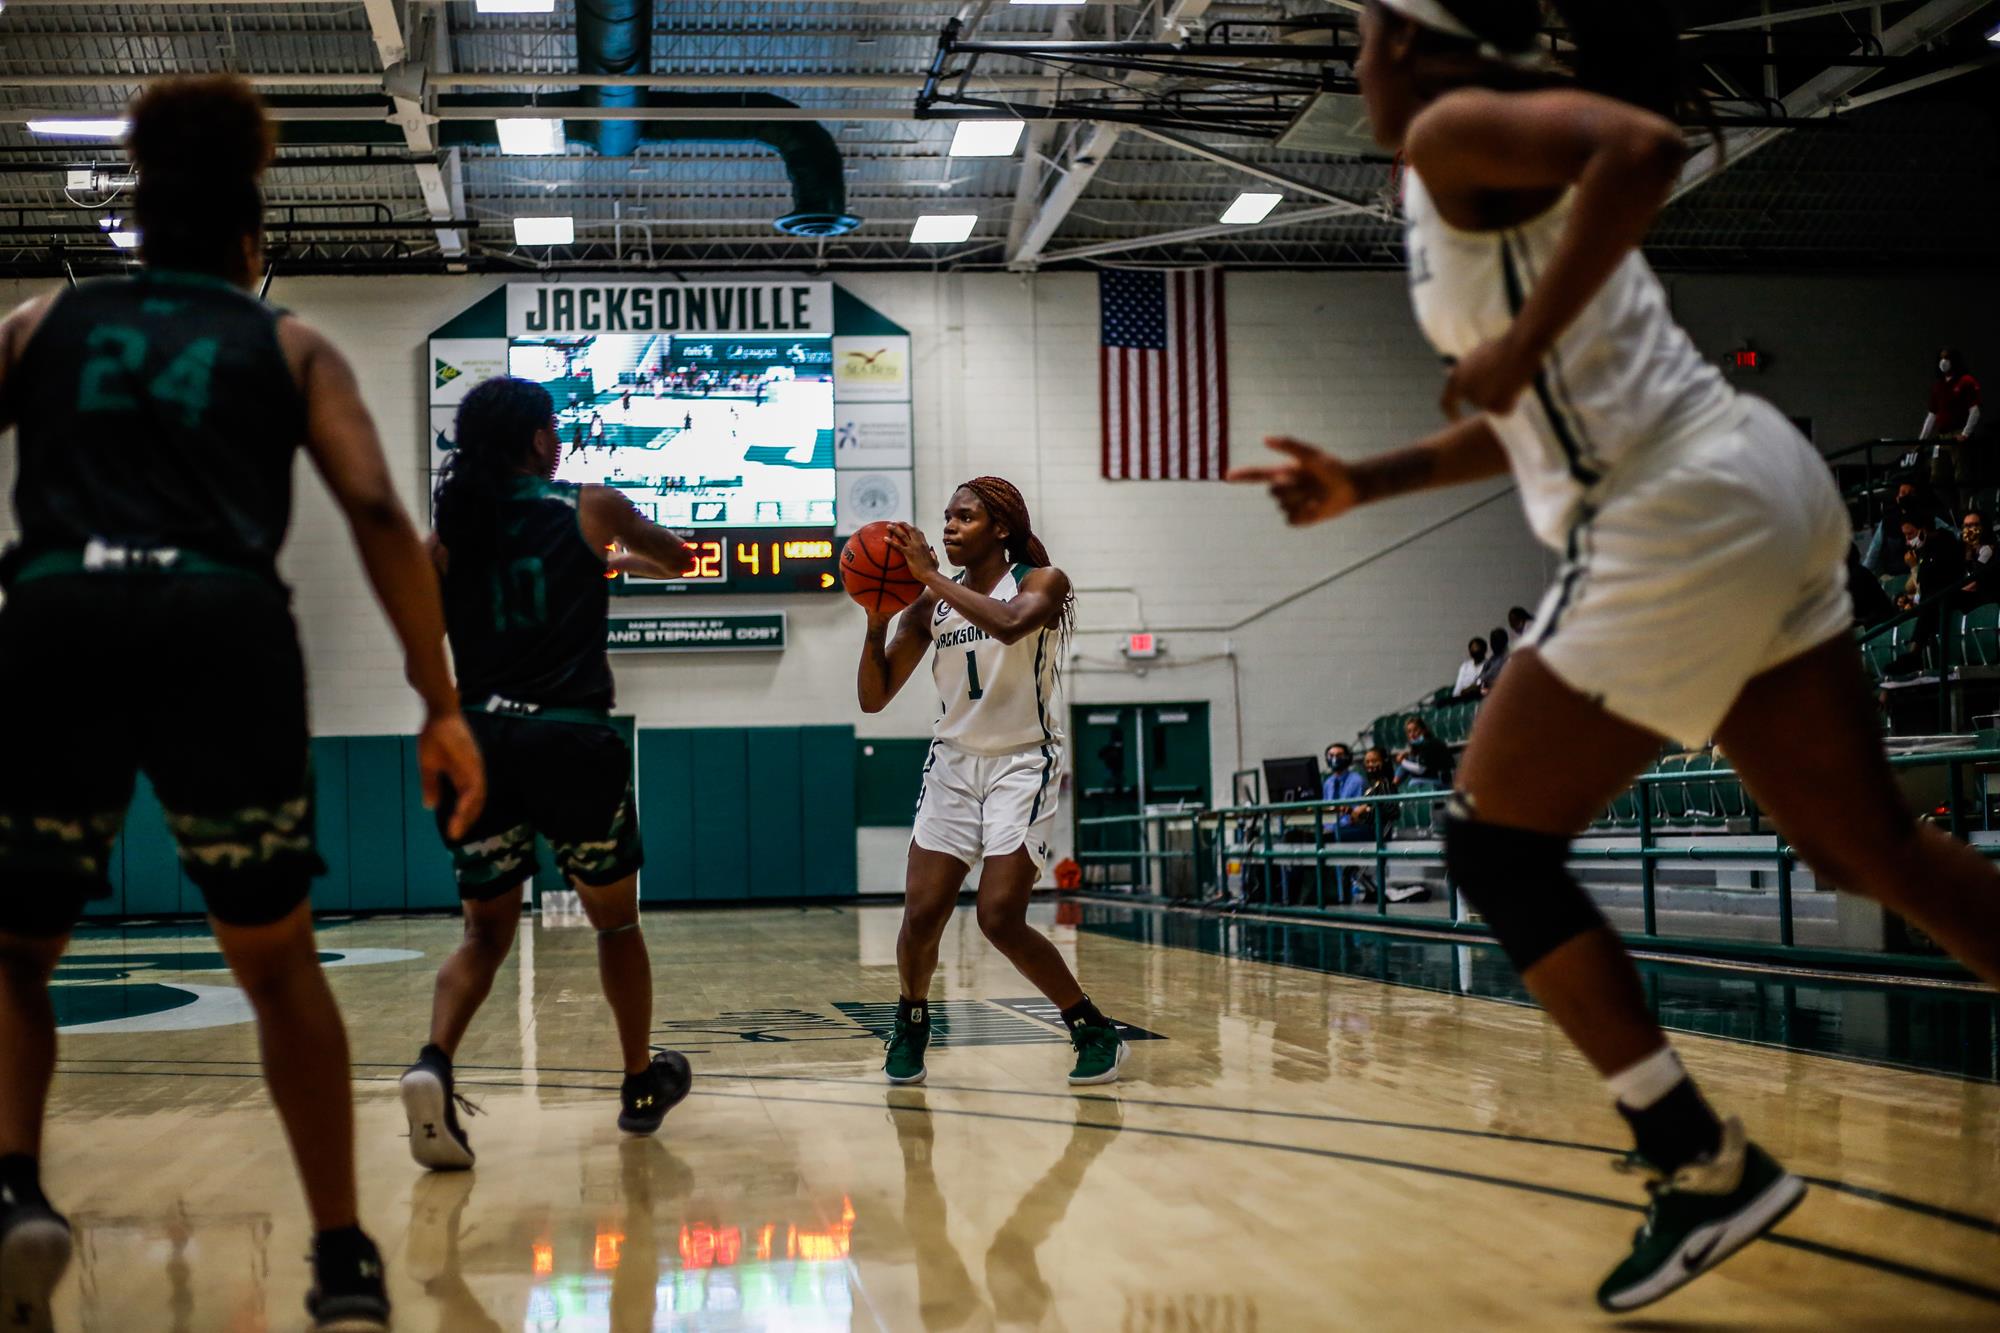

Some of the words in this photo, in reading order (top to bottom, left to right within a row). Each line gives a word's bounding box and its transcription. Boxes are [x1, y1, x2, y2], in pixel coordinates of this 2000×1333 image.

[525, 286, 812, 332] JACKSONVILLE
[77, 324, 219, 428] 24
[738, 543, 780, 575] 41
[491, 557, 547, 632] 10
[607, 631, 640, 642] AND
[645, 629, 732, 642] STEPHANIE
[628, 621, 657, 629] MADE
[660, 621, 707, 629] POSSIBLE
[710, 620, 724, 628] BY
[966, 650, 983, 700] 1
